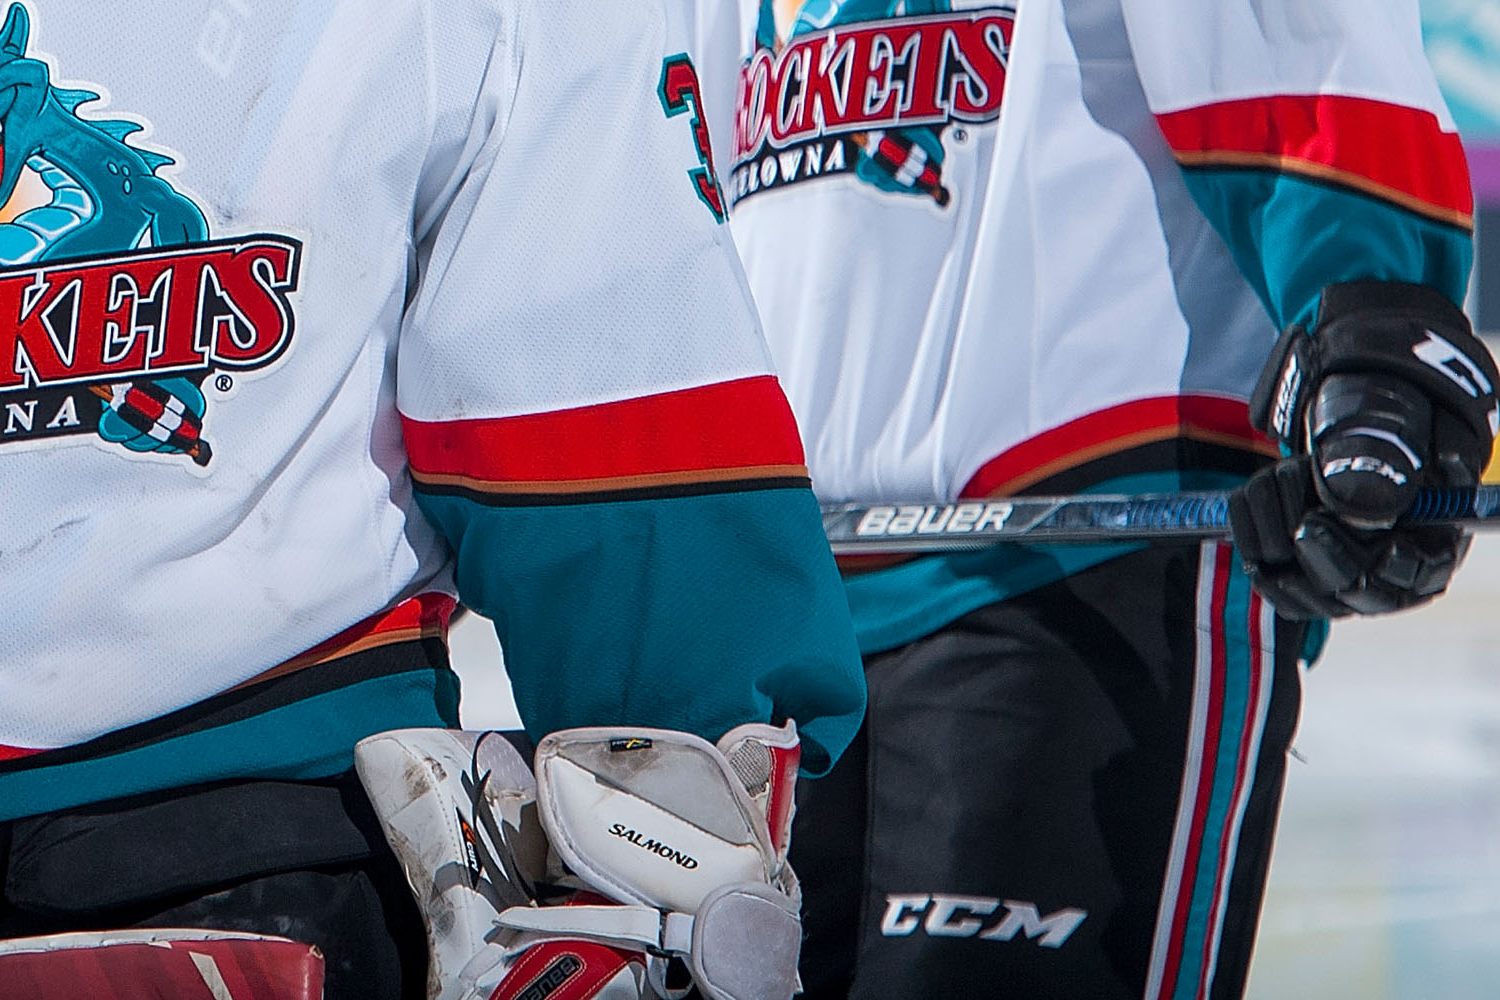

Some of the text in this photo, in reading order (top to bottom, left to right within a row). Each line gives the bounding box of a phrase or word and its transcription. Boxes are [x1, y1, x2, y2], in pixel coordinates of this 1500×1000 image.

[657, 52, 729, 225] 3
[731, 140, 846, 198] ELOWNA
[856, 503, 1013, 536] BAUER
[608, 823, 698, 871] SALMOND
[881, 893, 1089, 949] CCM
[519, 957, 577, 1000] BAUE
